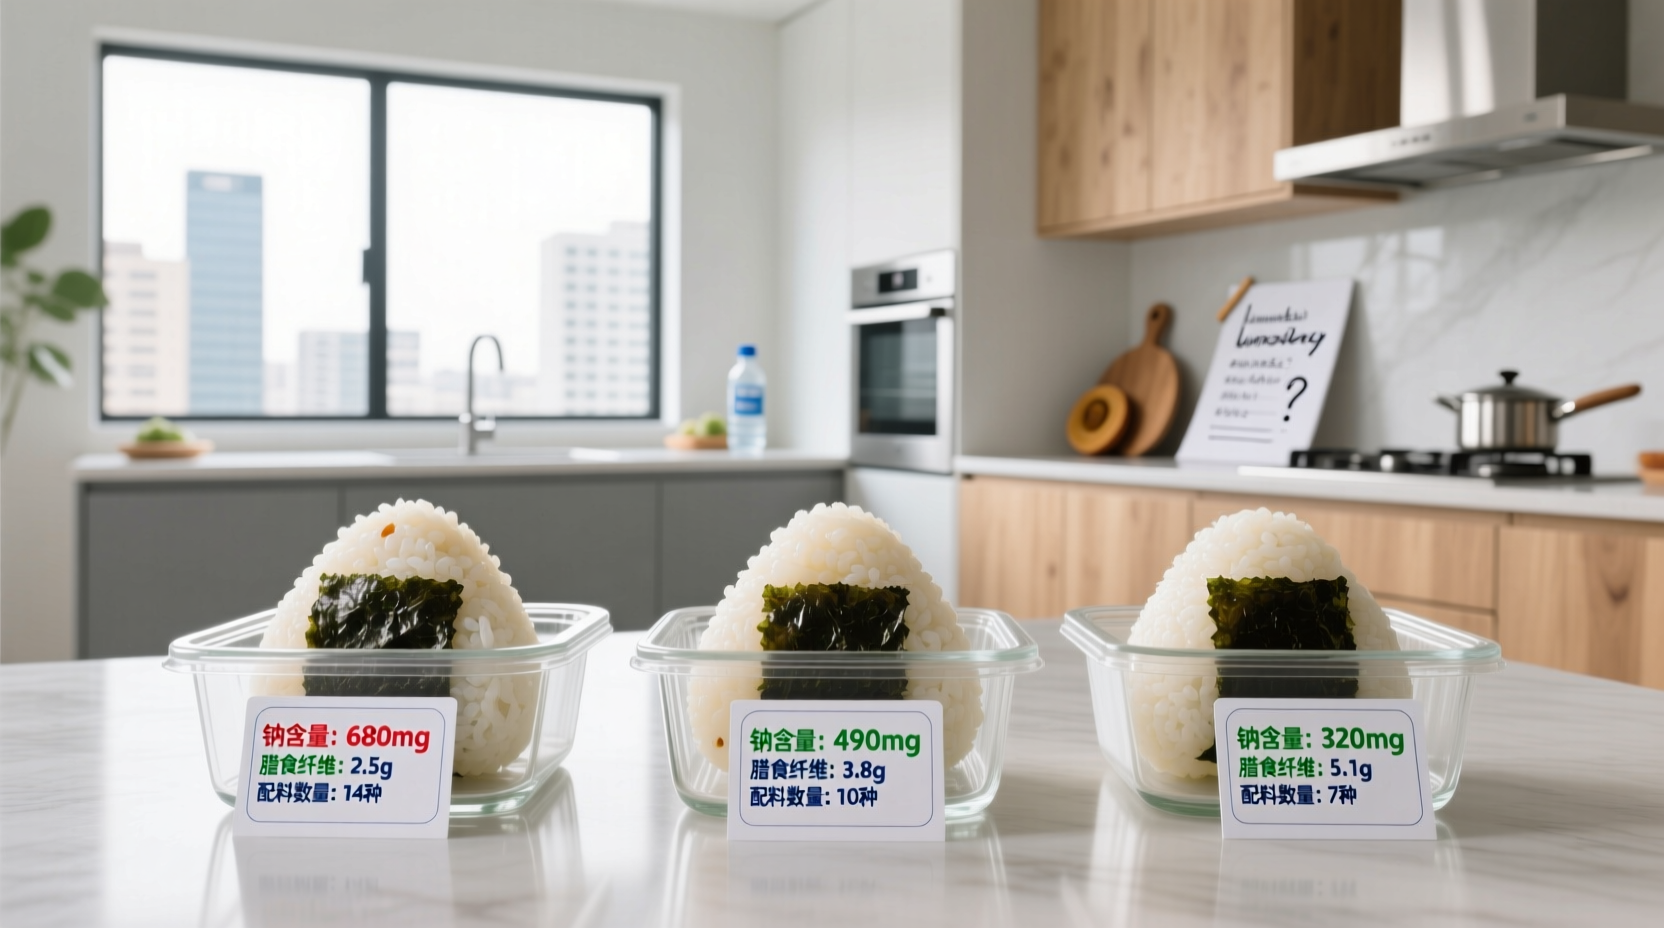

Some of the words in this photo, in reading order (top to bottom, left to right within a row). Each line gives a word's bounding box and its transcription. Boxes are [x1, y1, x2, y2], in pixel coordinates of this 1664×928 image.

[346, 725, 430, 754] 680mg
[833, 728, 921, 757] 490mg
[1321, 727, 1404, 756] 320mg
[350, 756, 393, 780] 2.5g
[842, 761, 886, 784] 3.8g
[1330, 758, 1373, 782] 5.1g
[343, 783, 382, 804] 14种
[836, 786, 878, 807] 10种
[1327, 785, 1357, 805] 7种
